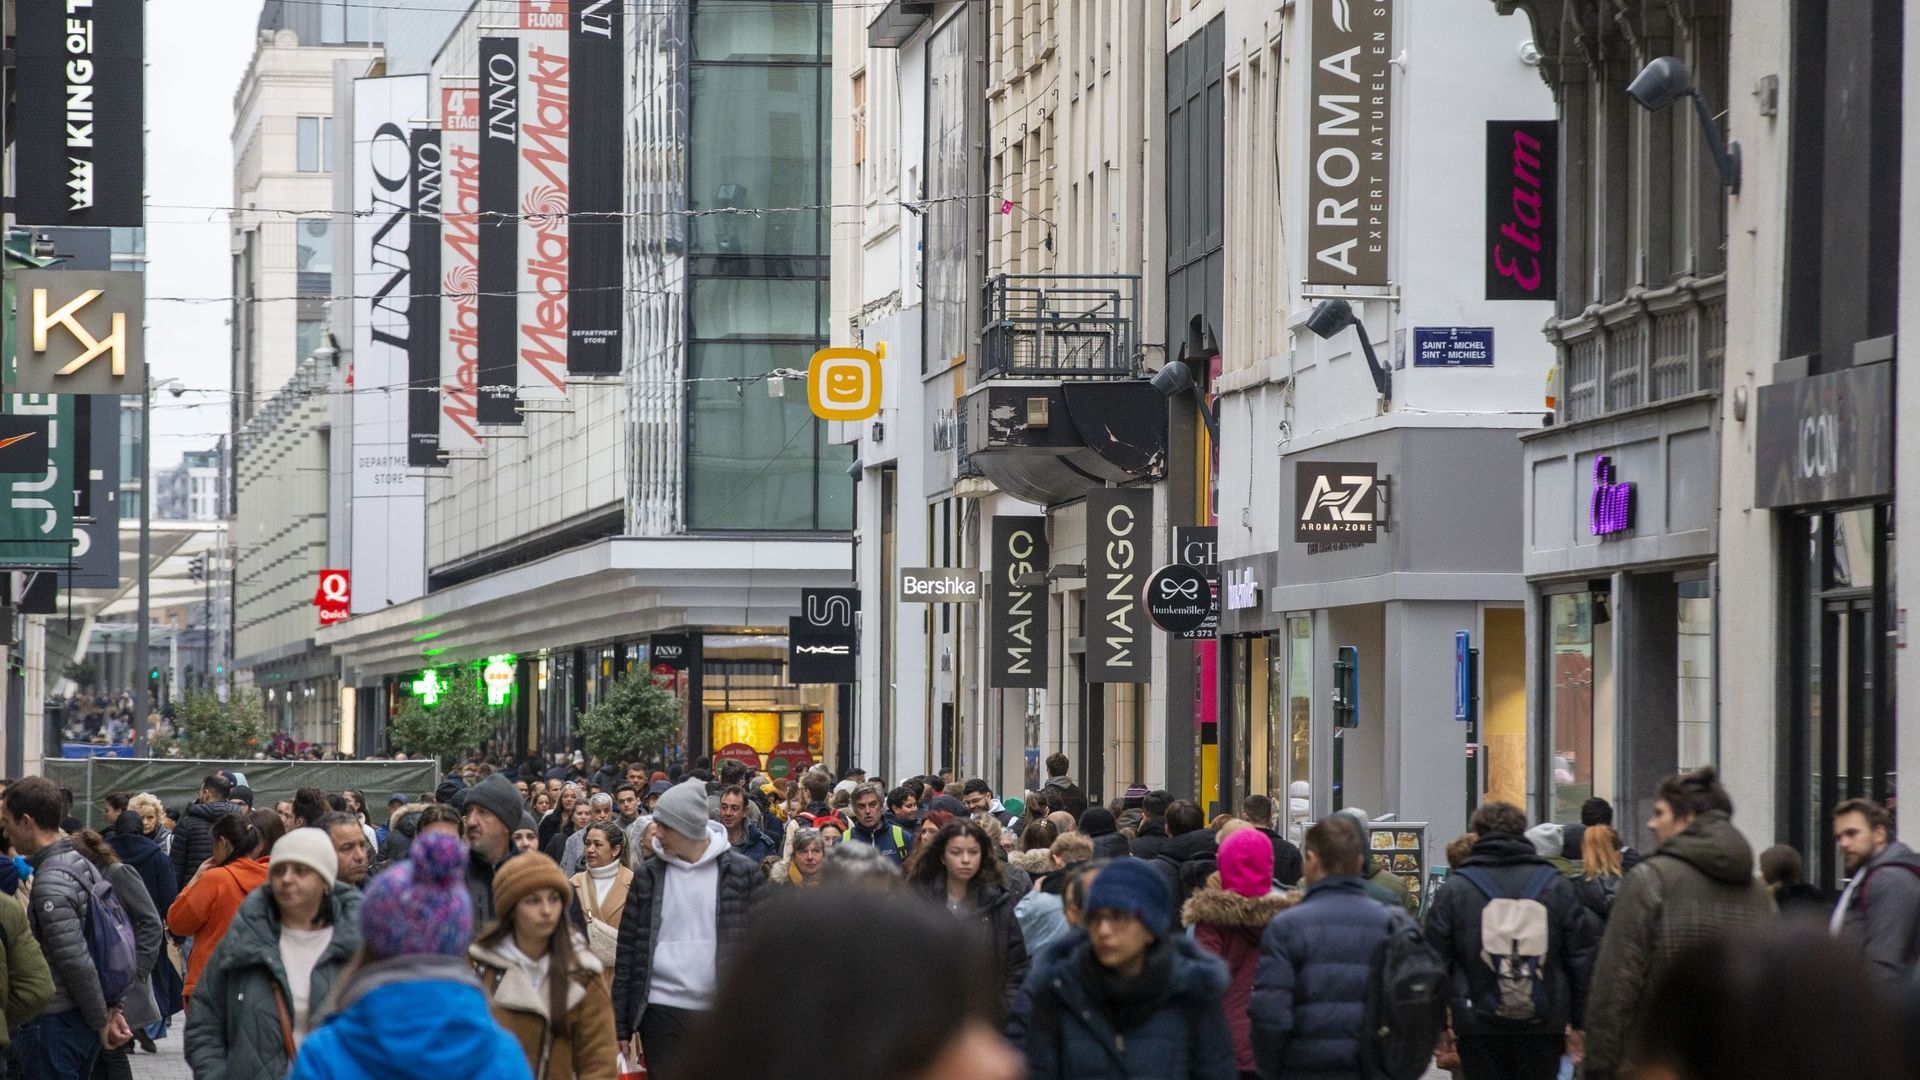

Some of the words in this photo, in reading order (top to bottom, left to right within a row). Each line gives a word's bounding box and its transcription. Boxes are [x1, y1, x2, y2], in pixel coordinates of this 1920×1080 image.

[67, 19, 90, 53] OF
[527, 13, 564, 28] FLOOR
[1372, 31, 1386, 55] EN
[67, 59, 94, 148] KING
[488, 53, 516, 144] INNO
[1370, 69, 1386, 161] NATUREL
[522, 46, 569, 194] Markt
[1316, 45, 1361, 276] AROMA
[418, 142, 441, 222] INNO
[1369, 176, 1383, 252] EXPERT
[1493, 130, 1542, 291] Etam
[371, 122, 412, 351] INNO
[520, 229, 569, 395] Media
[1422, 341, 1447, 350] SAINT
[1454, 341, 1486, 350] MICHEL
[1422, 351, 1441, 359] SINT
[1448, 351, 1487, 359] MICHIELS
[374, 473, 404, 484] STORE
[1301, 475, 1373, 521] AZ
[1300, 523, 1373, 532] AROMA-ZONE
[322, 573, 349, 603] Q
[903, 576, 976, 595] Bershka
[1008, 530, 1034, 674] MANGO
[1106, 504, 1135, 668] MANGO
[320, 609, 348, 620] Quick
[1152, 605, 1206, 615] hunkemöller
[655, 646, 683, 656] INNO
[1197, 630, 1213, 638] 373
